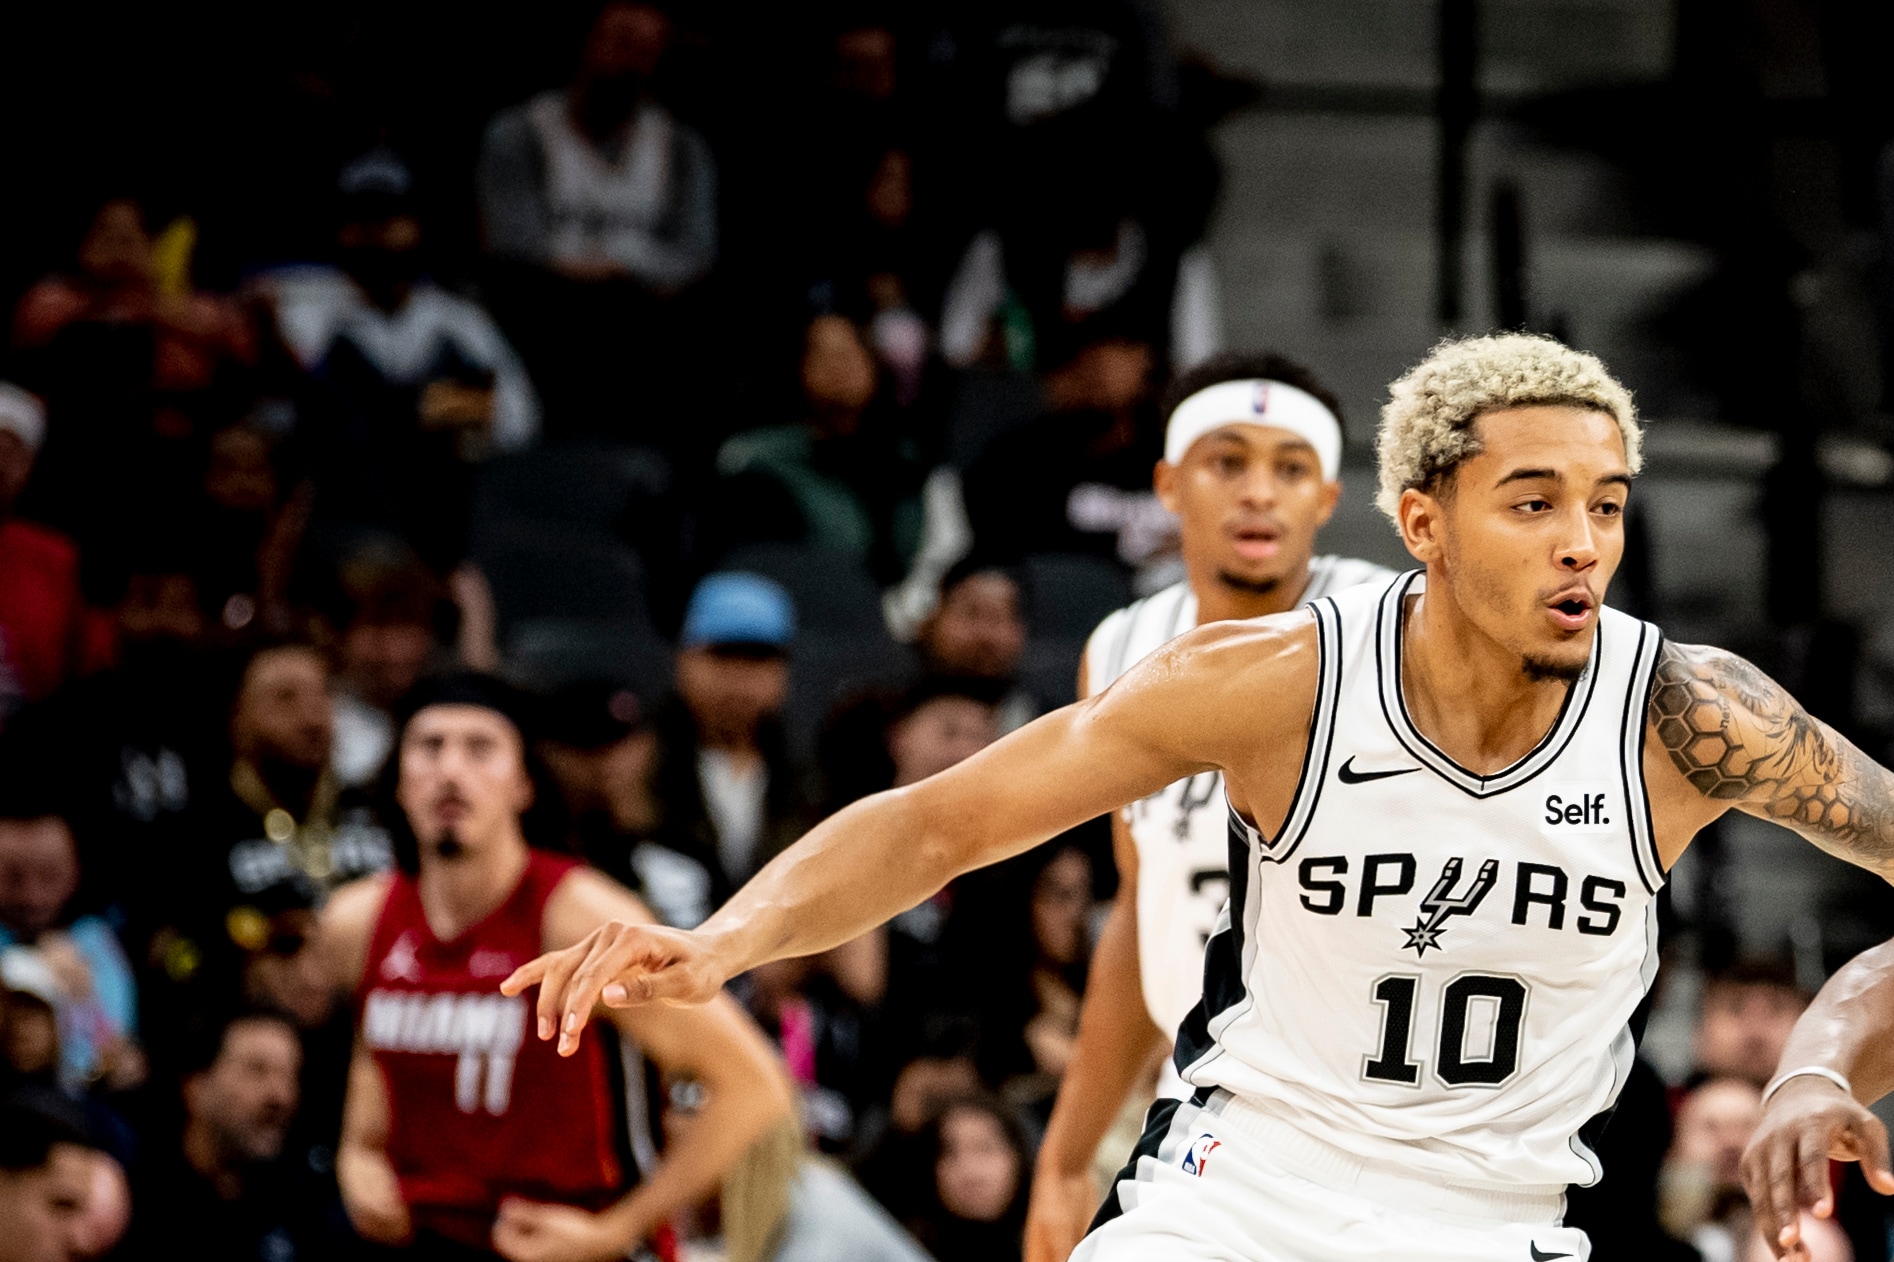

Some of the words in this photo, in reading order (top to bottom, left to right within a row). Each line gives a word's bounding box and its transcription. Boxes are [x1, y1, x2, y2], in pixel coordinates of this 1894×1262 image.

[1545, 793, 1611, 826] Self.
[1298, 852, 1627, 958] SPURS
[363, 988, 529, 1055] MIAMI
[1360, 970, 1531, 1090] 10
